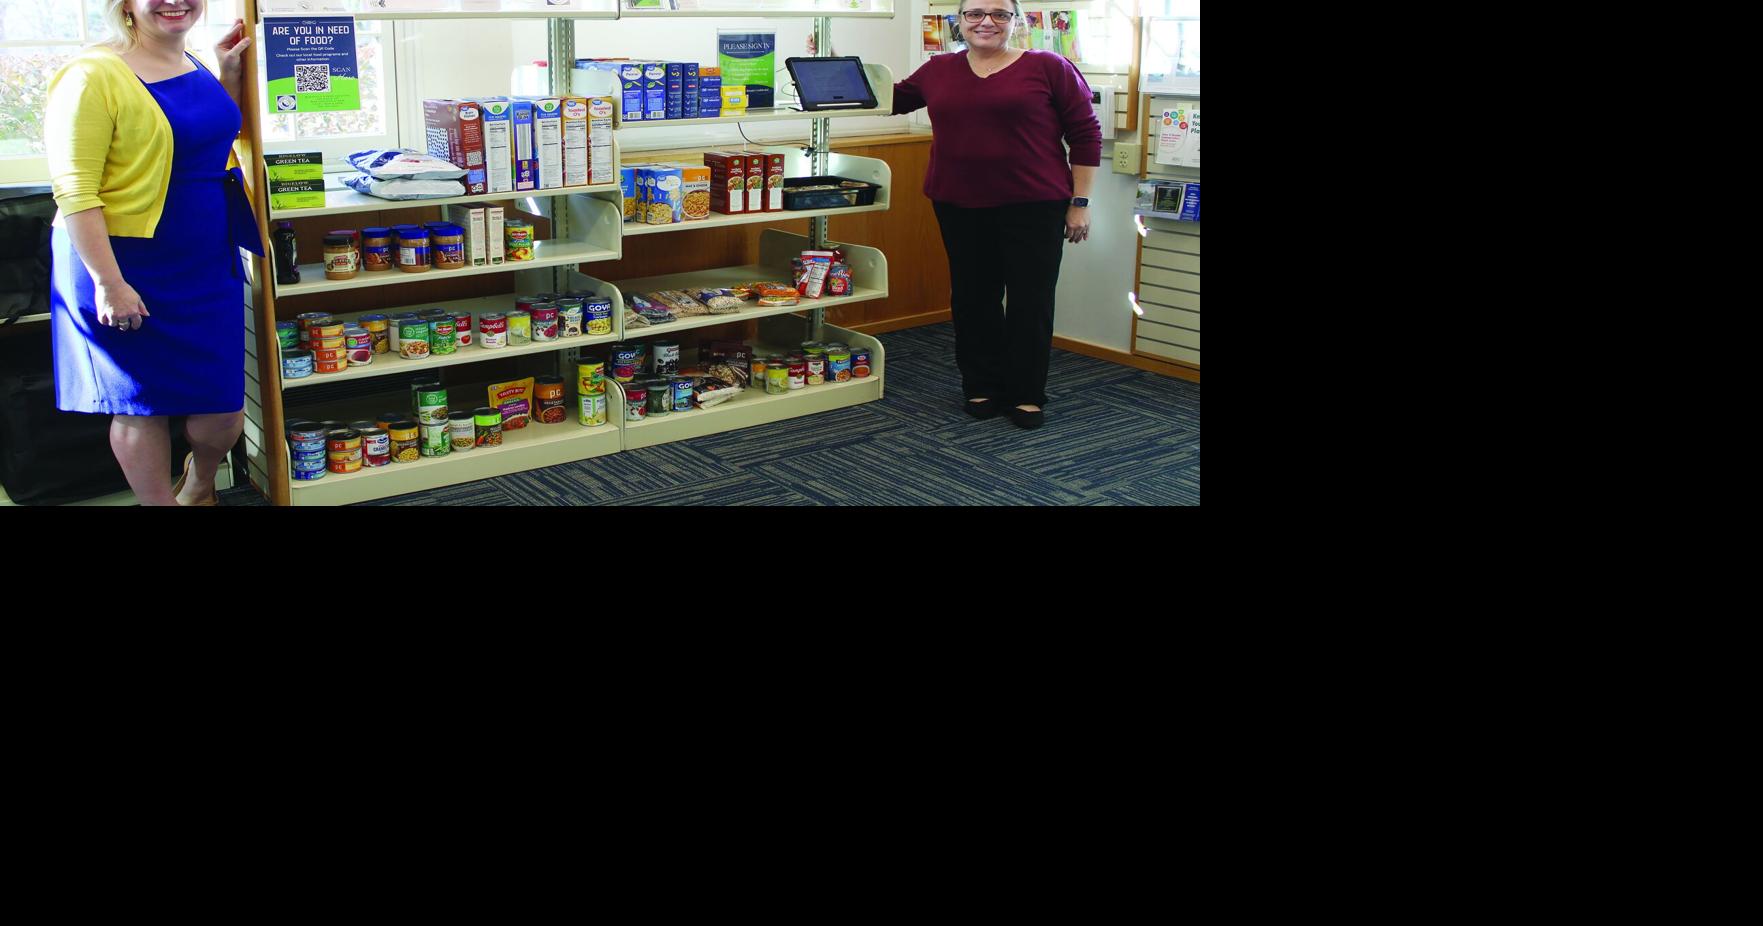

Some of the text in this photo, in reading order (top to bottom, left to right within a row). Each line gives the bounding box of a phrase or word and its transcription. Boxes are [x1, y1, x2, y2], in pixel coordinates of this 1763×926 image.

[272, 25, 350, 36] ARE YOU IN NEED
[289, 36, 334, 45] OF FOOD?
[499, 390, 515, 398] TASTY
[550, 389, 561, 399] pc
